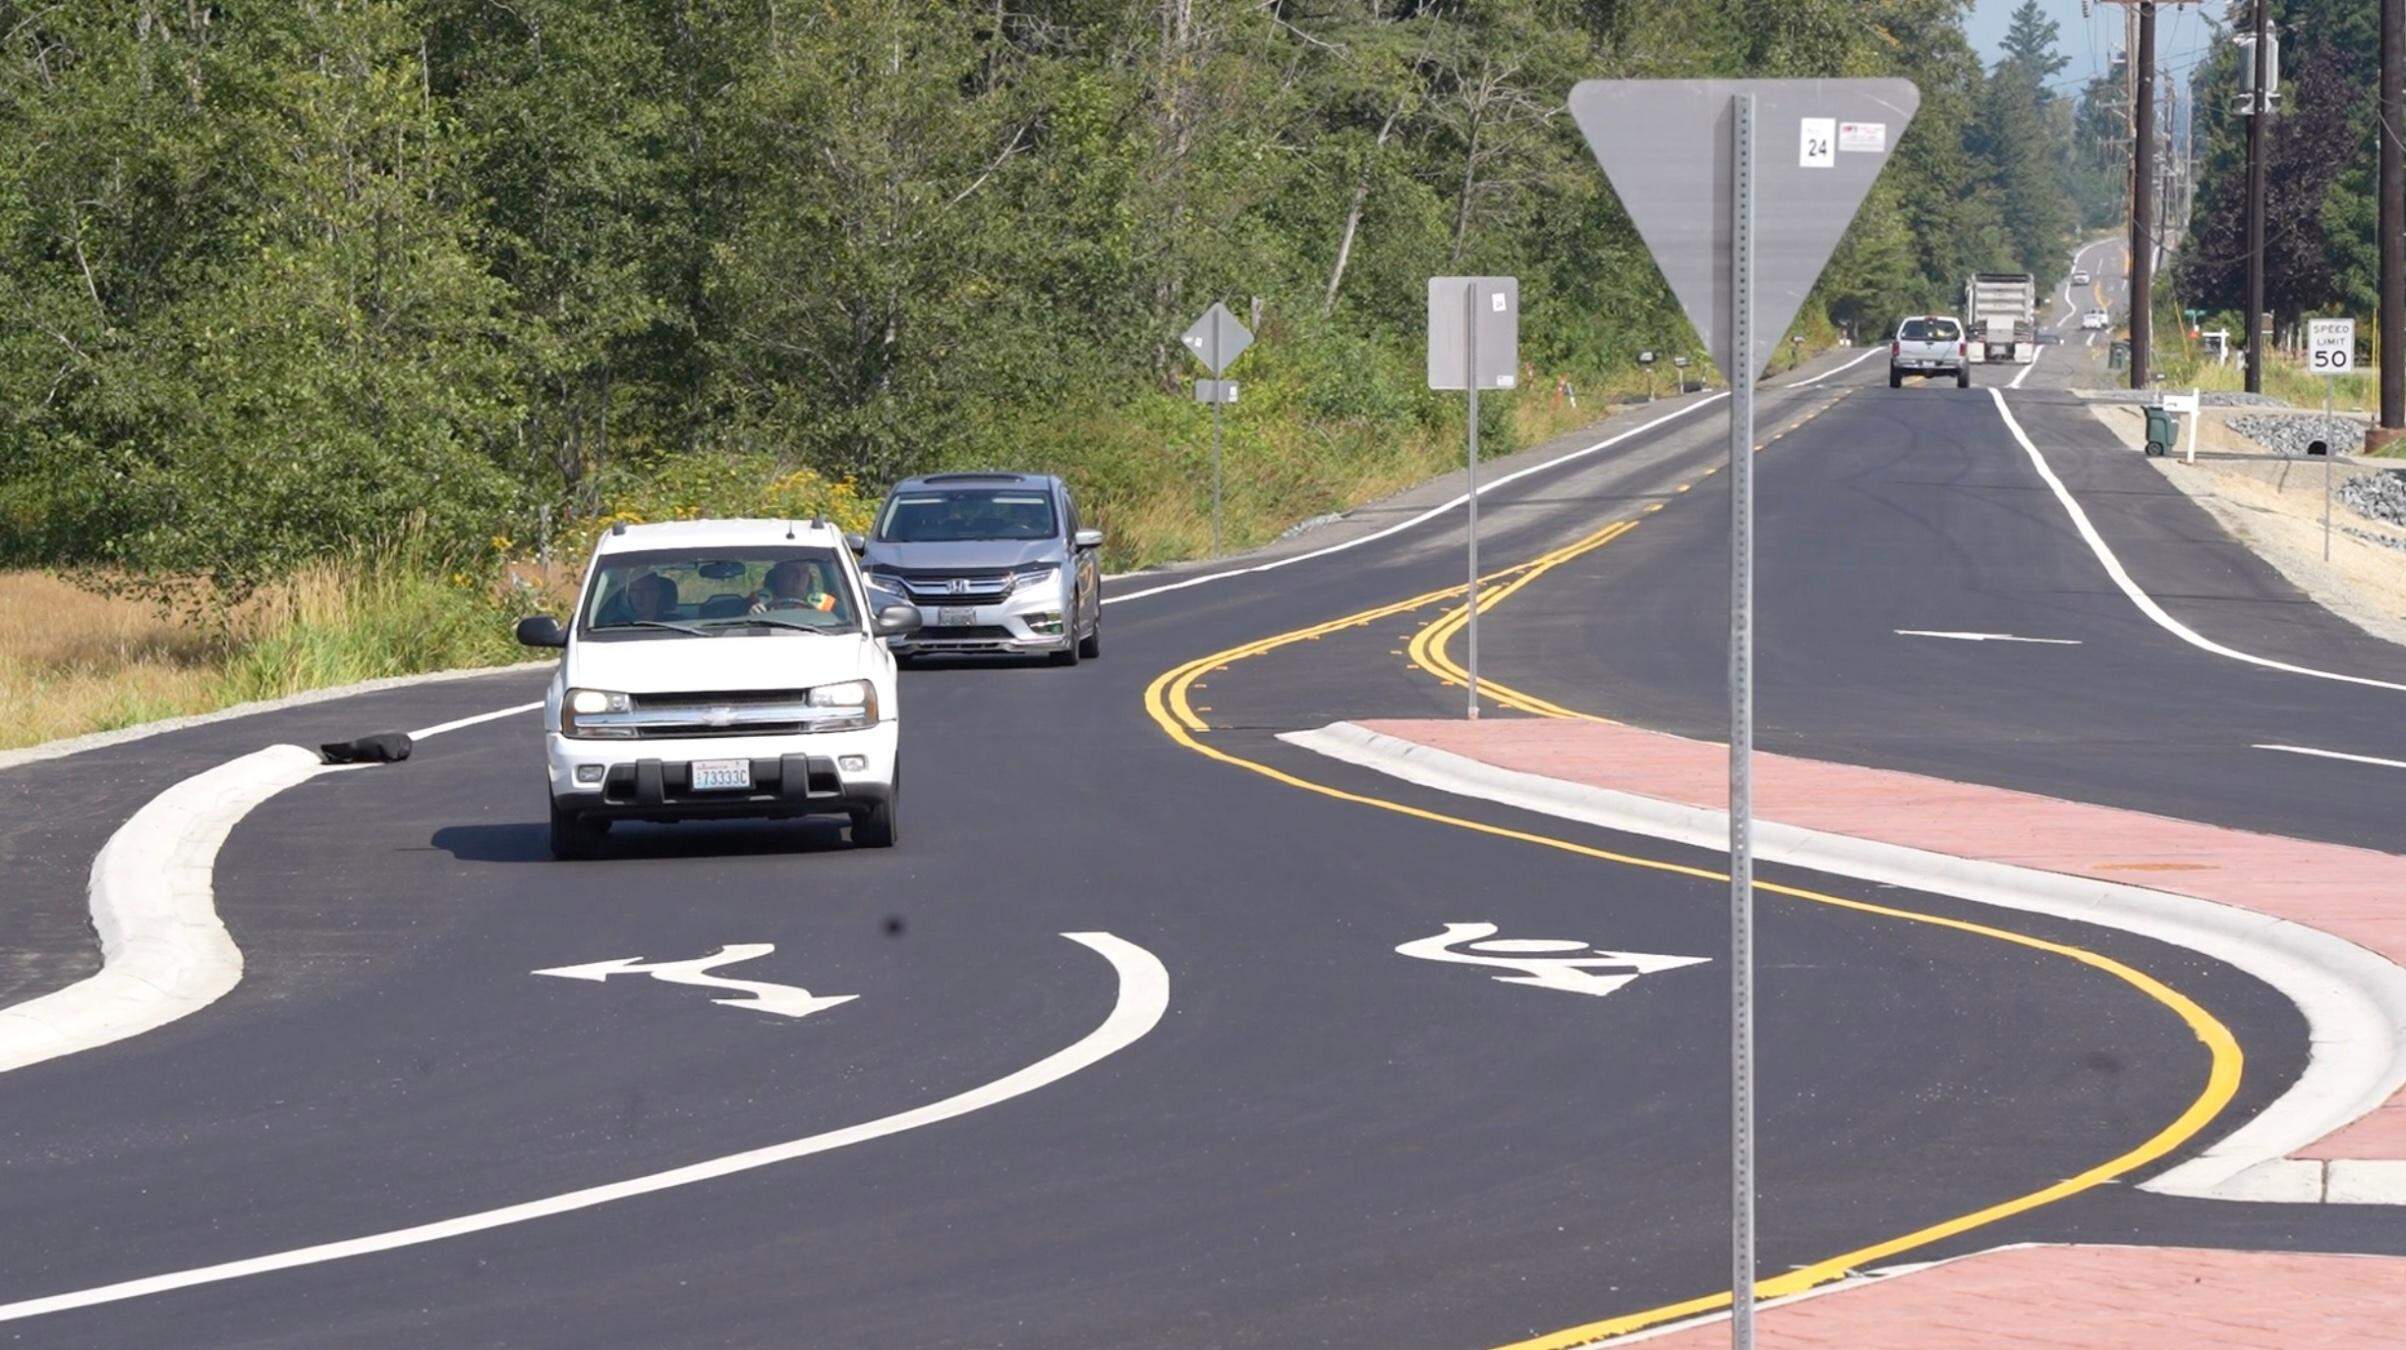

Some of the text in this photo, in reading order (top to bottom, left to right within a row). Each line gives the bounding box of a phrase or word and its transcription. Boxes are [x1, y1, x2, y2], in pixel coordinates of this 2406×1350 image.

[1808, 139, 1827, 157] 24
[2313, 324, 2350, 334] SPEED
[2316, 338, 2346, 346] LIMIT
[2314, 350, 2347, 368] 50
